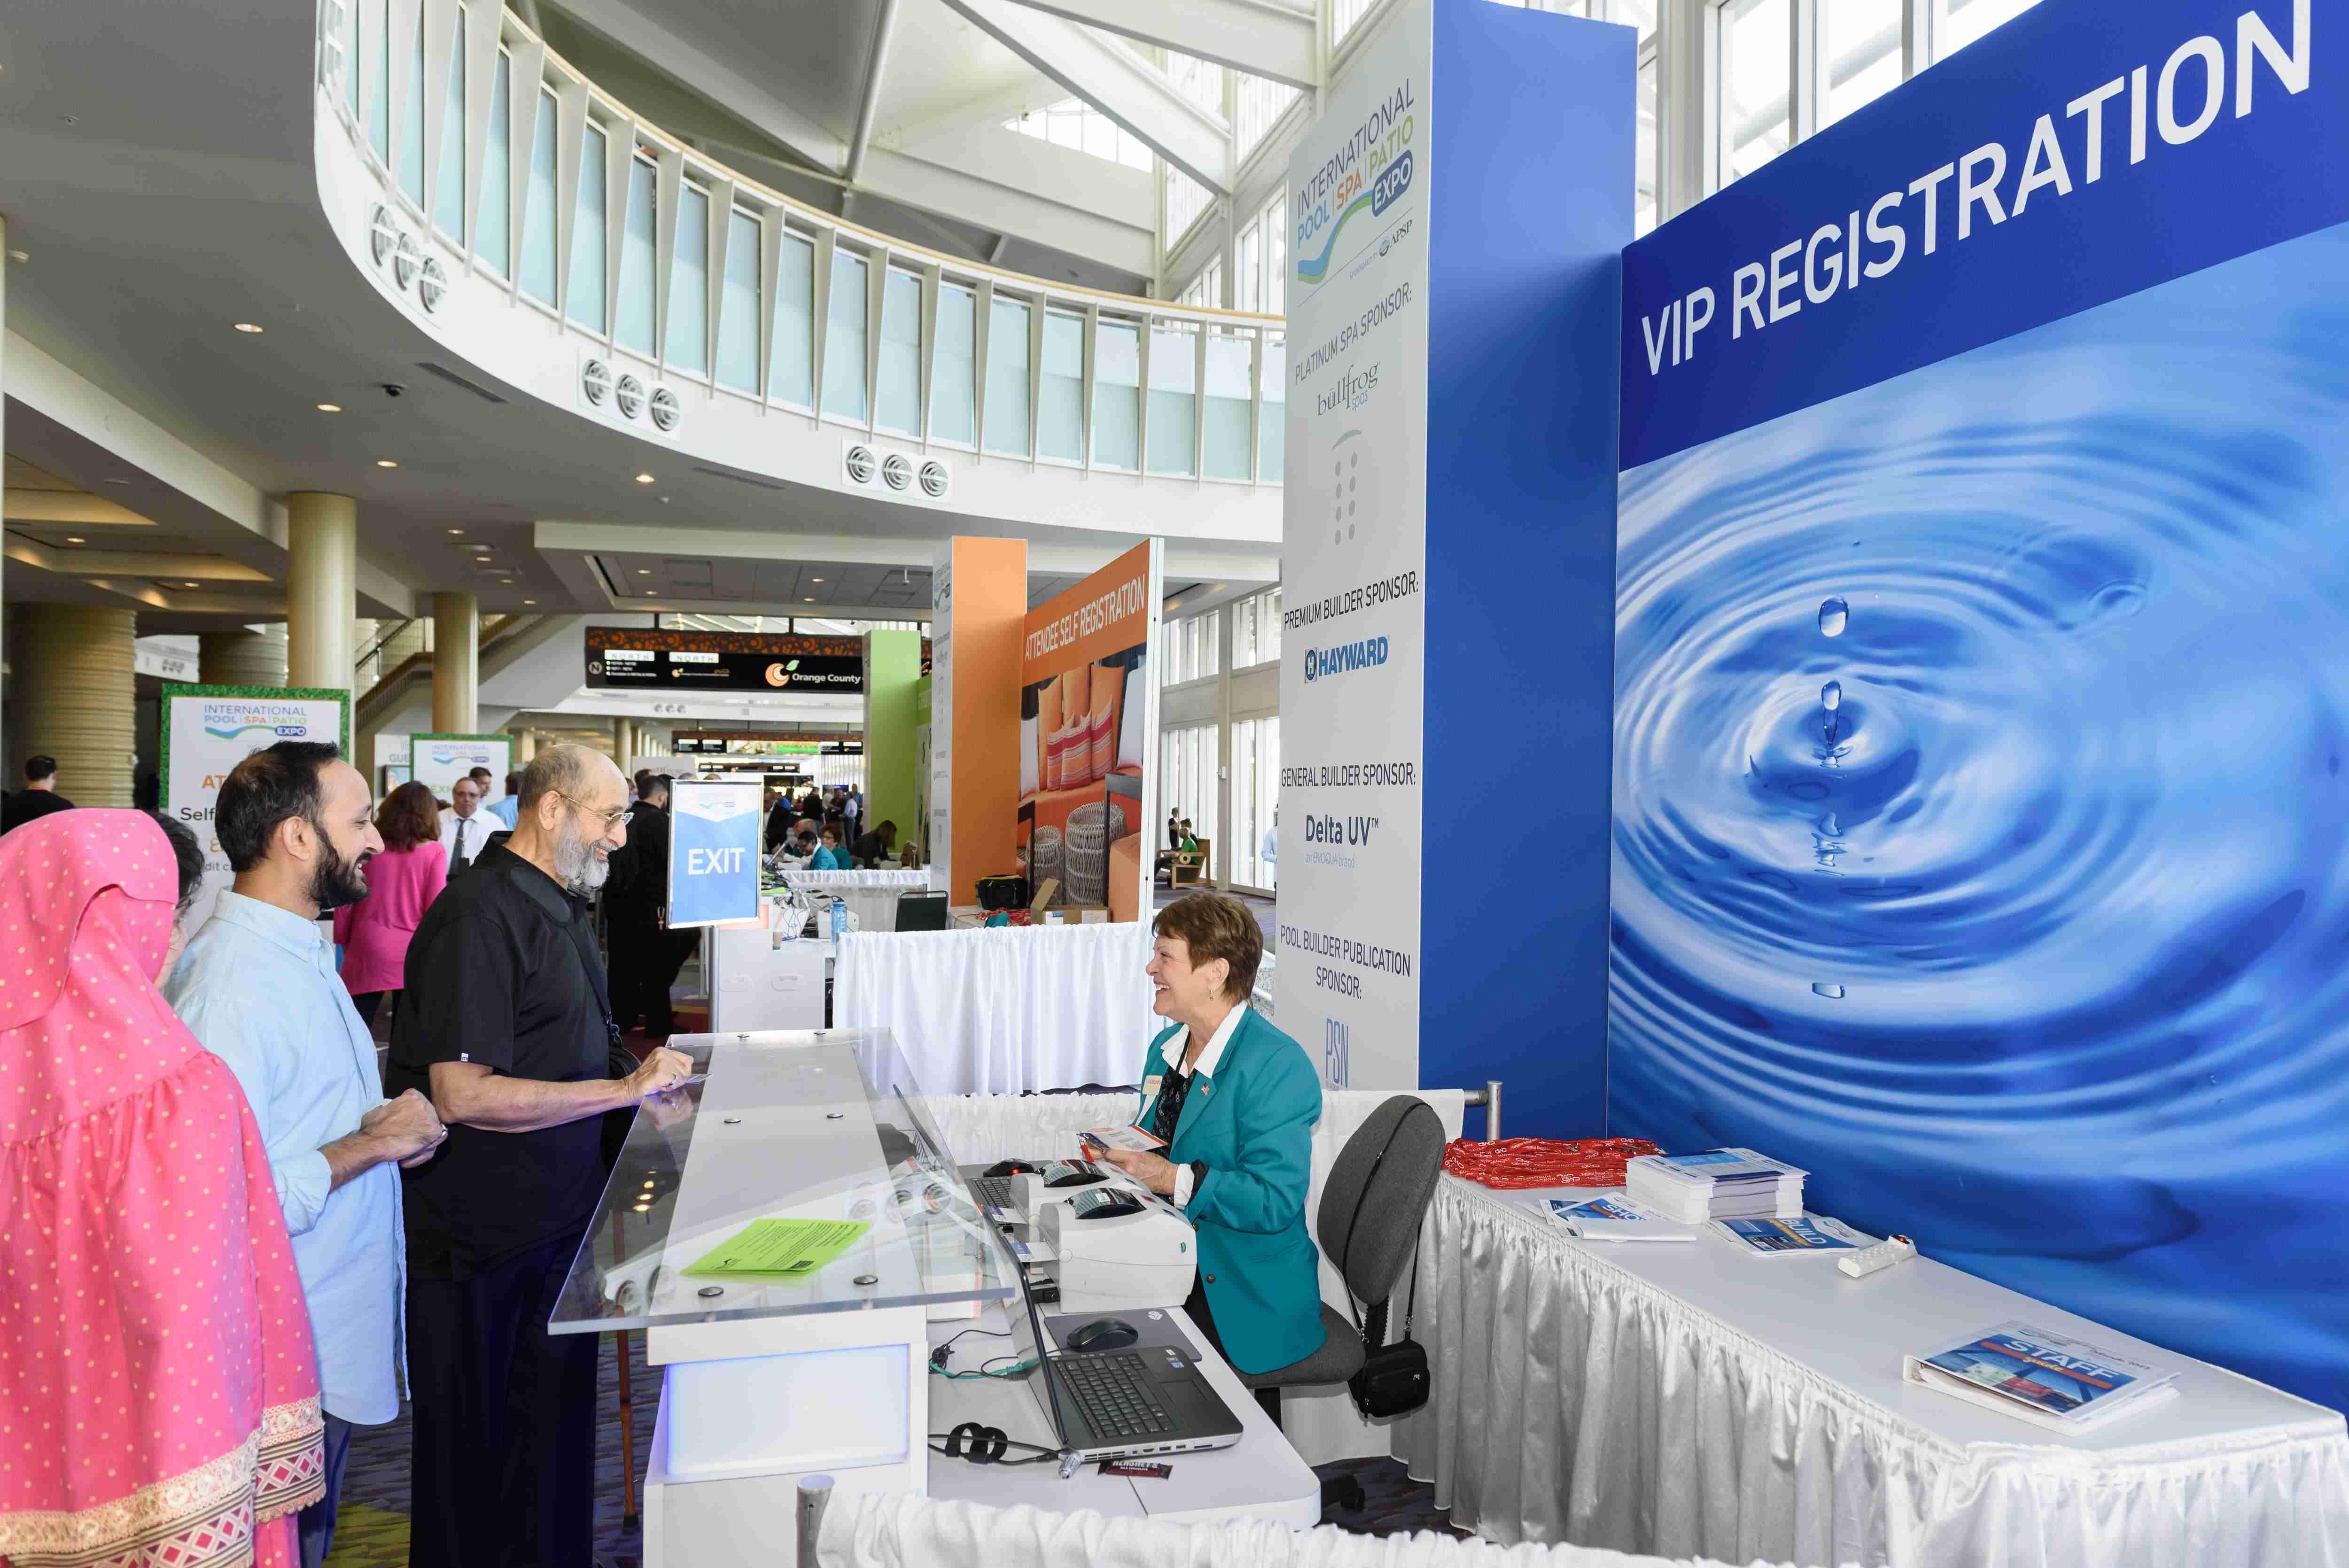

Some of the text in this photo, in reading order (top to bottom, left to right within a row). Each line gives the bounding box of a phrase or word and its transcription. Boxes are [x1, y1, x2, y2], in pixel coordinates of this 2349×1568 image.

[1298, 78, 1414, 220] INTERNATIONAL
[1298, 115, 1414, 248] POOL SPA PATIO
[1374, 157, 1411, 211] EXPO
[1641, 0, 2310, 376] VIP REGISTRATION
[1390, 219, 1412, 248] APSP
[1295, 281, 1412, 385] PLATINUM SPA SPONSOR:
[1025, 574, 1145, 661] ATTENDEE SELF REGISTRATION
[1284, 571, 1418, 631] PREMIUM BUILDER SPONSOR:
[1319, 636, 1388, 676] HAYWARD
[792, 673, 861, 684] Orange County
[204, 705, 306, 715] INTERNATIONAL
[204, 715, 237, 723] POOL
[277, 727, 305, 736] EXPO
[1281, 762, 1416, 787] GENERAL BUILDER SPONSOR:
[1306, 814, 1342, 844] Delta
[687, 847, 746, 876] EXIT
[1281, 925, 1410, 977] POOL BUILDER PUBLICATION
[1316, 966, 1362, 1000] SPONSOR:
[1325, 1018, 1349, 1087] PSN
[1602, 1204, 1647, 1221] SHO
[2003, 1340, 2120, 1378] STAFF
